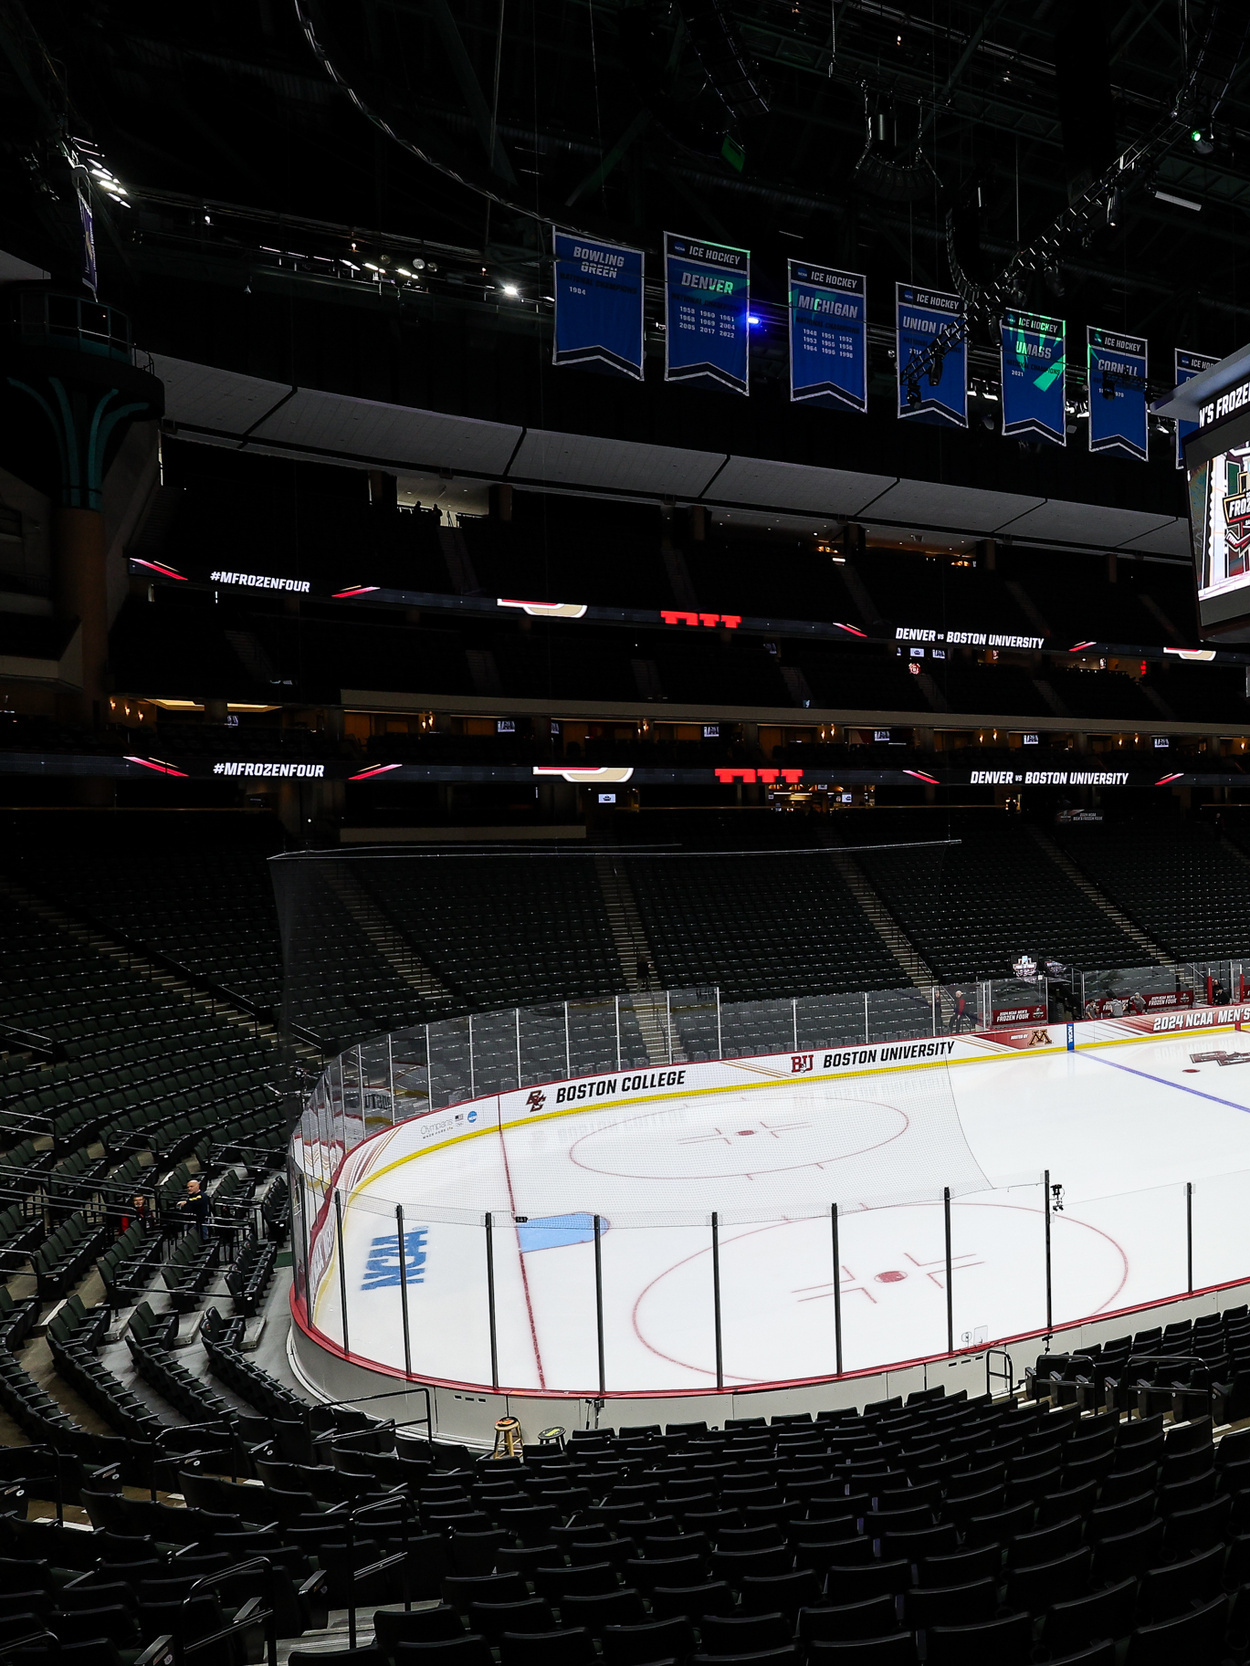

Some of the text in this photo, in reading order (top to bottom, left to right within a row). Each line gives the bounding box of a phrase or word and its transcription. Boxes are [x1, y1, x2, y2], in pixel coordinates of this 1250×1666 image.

[573, 246, 625, 267] BOWLING
[689, 245, 740, 265] ICE HOCKEY
[581, 261, 618, 278] GREEN
[681, 272, 734, 295] DENVER
[811, 271, 857, 288] ICE HOCKEY
[798, 295, 858, 318] MICHIGAN
[917, 293, 959, 310] ICE HOCKEY
[902, 315, 937, 334] UNION
[1018, 317, 1030, 328] ICE
[1030, 320, 1058, 333] HOCKEY
[1015, 340, 1052, 359] UMASS
[1104, 336, 1141, 352] ICE HOCKEY
[1190, 358, 1201, 368] ICE
[210, 571, 311, 593] #MFROZENFOUR
[895, 627, 936, 642] DENVER
[946, 631, 987, 645] BOSTON
[988, 634, 1045, 649] UNIVERSITY
[213, 762, 325, 777] #MFROZENFOUR
[970, 770, 1014, 784] DENVER
[1024, 771, 1068, 785] BOSTON
[1069, 772, 1129, 785] UNIVERSITY
[996, 1012, 1031, 1023] FROZEN FOUR
[1153, 1016, 1184, 1031] 2024
[1185, 1012, 1213, 1027] NCAA
[1217, 1007, 1250, 1024] MEN'S
[1028, 1029, 1053, 1047] M
[791, 1054, 814, 1073] BU
[823, 1041, 955, 1069] BOSTON UNIVERSITY
[556, 1070, 687, 1104] BOSTON COLLEGE
[361, 1228, 428, 1290] NCAA
